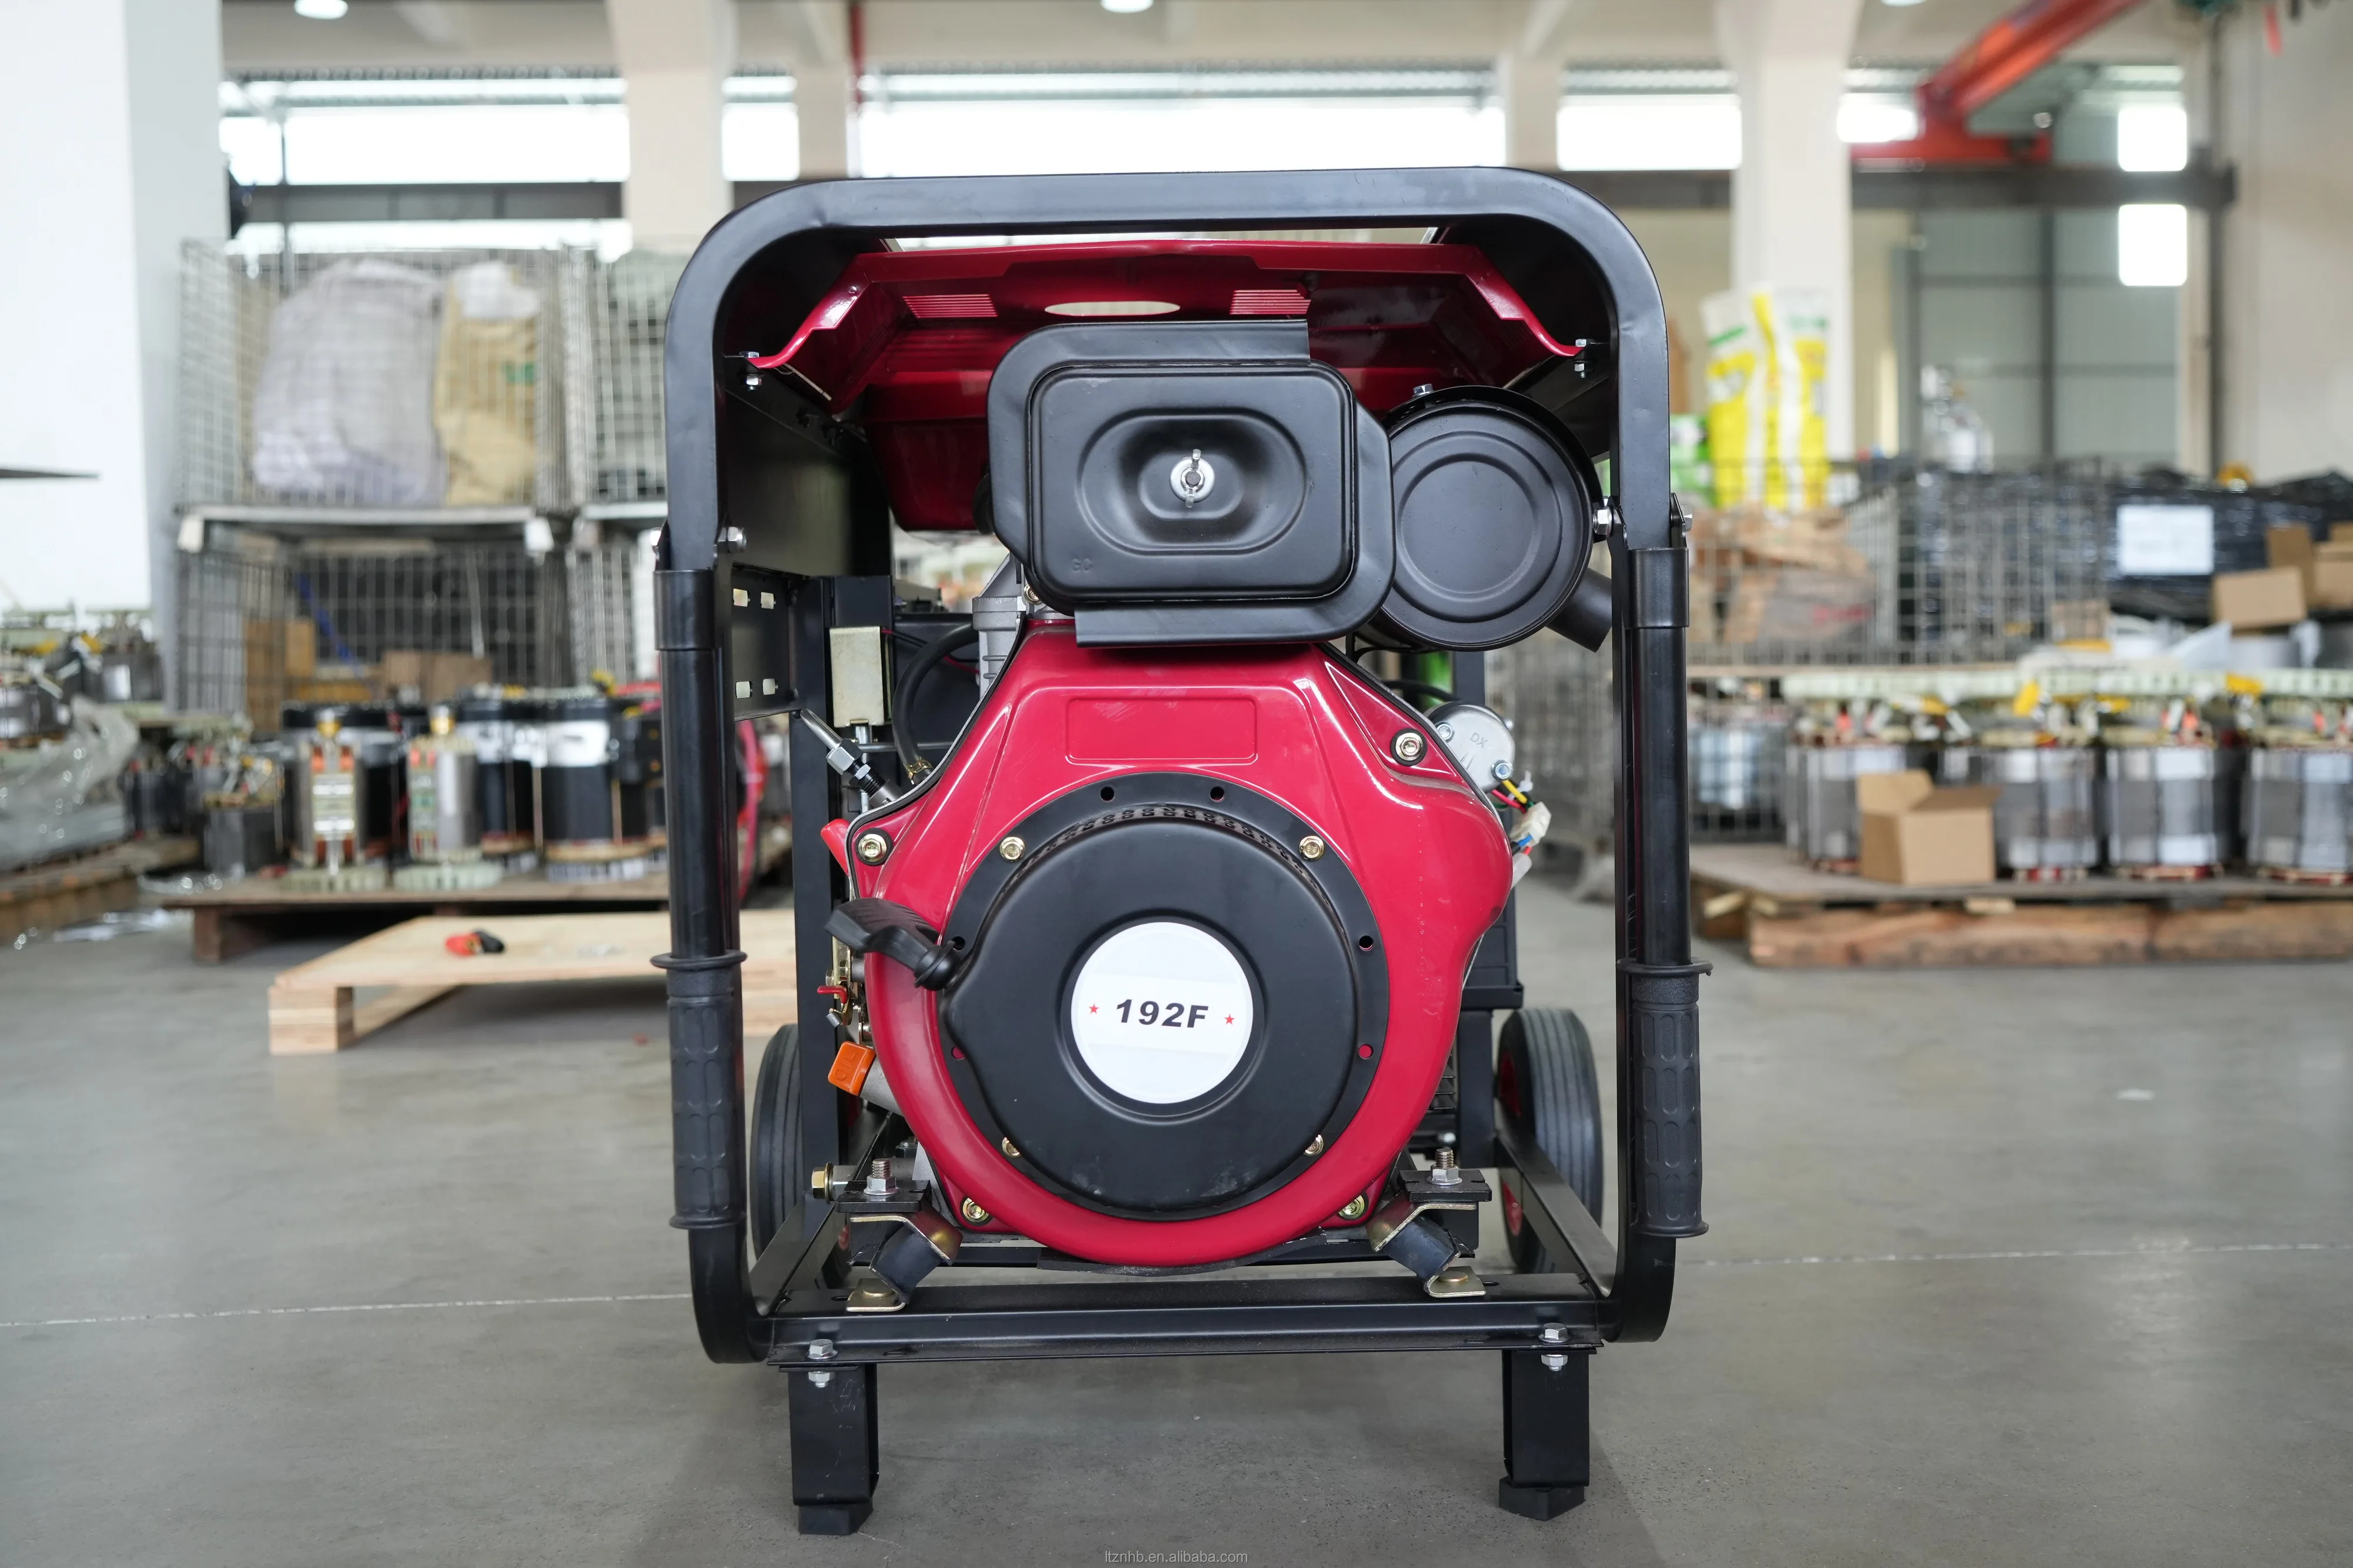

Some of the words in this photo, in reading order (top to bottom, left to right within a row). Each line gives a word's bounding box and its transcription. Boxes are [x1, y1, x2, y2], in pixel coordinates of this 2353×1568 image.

[1470, 732, 1488, 748] DX
[1116, 999, 1209, 1028] 192F
[834, 1051, 858, 1081] OIL
